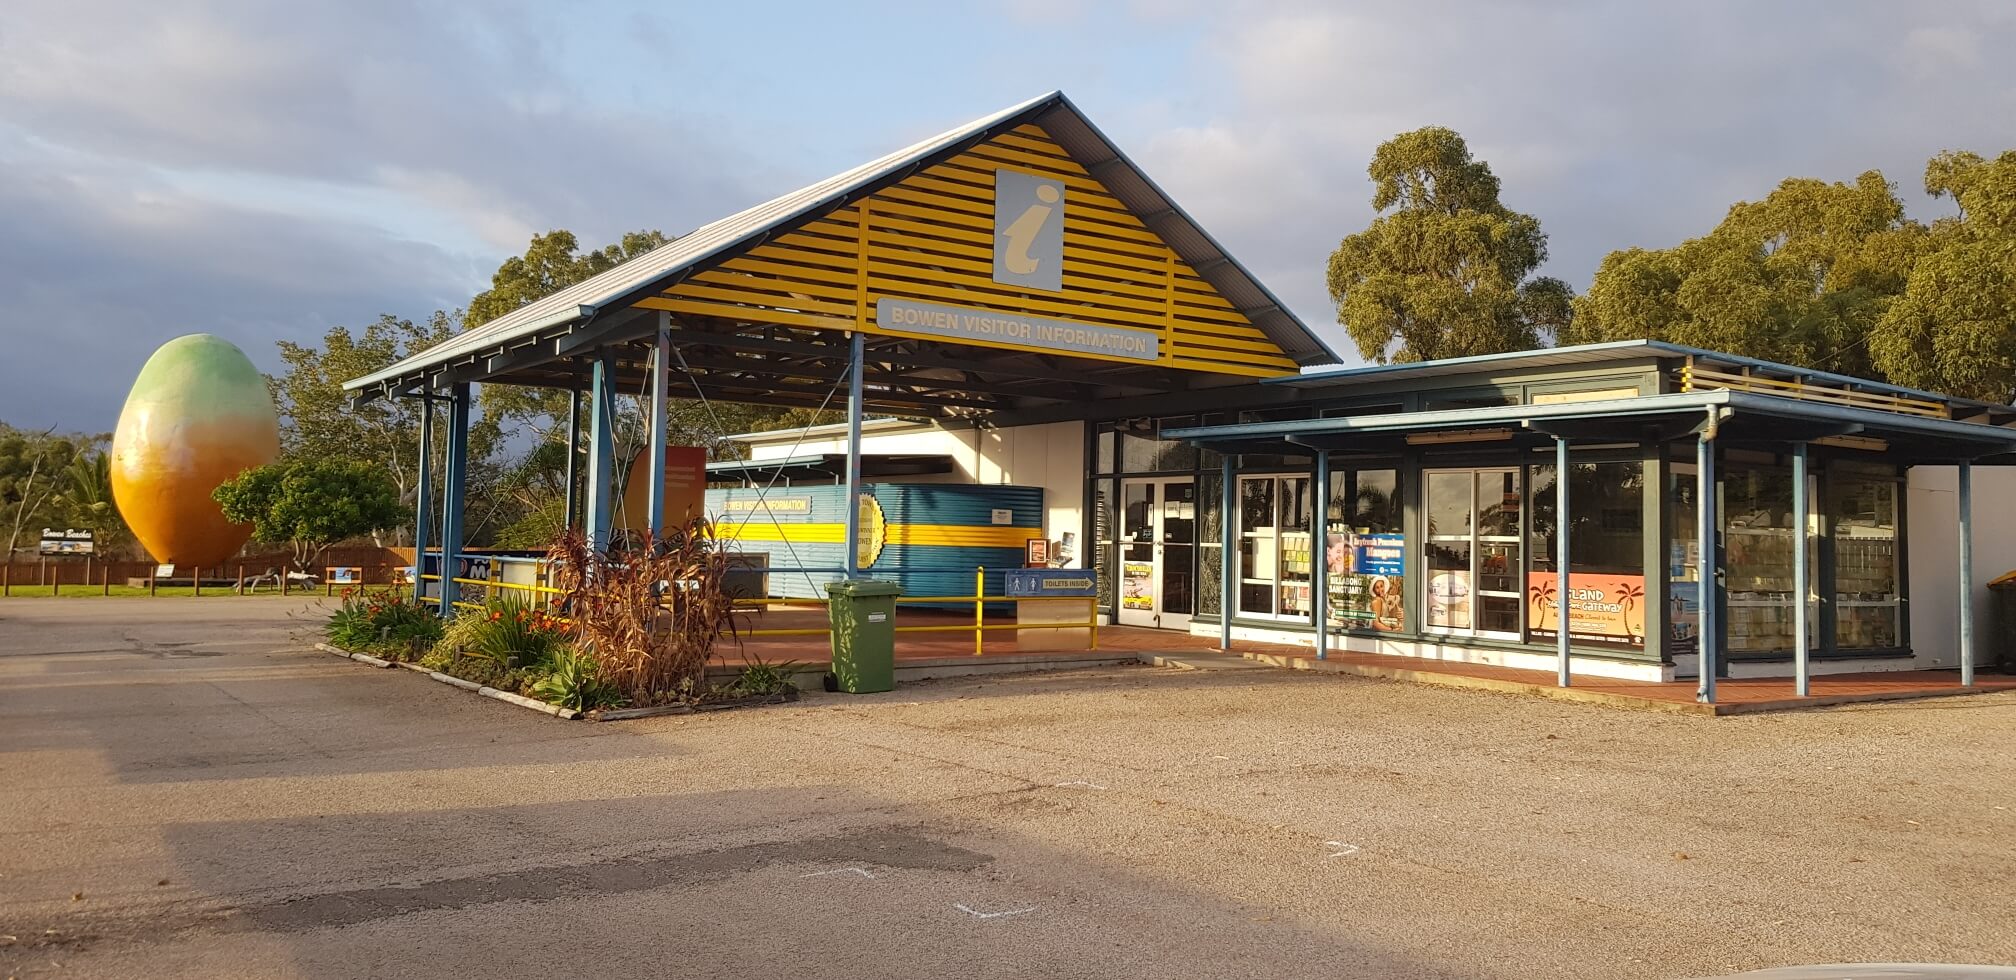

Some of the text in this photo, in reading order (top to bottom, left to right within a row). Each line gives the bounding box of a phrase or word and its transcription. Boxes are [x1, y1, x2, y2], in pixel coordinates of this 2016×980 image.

[1002, 184, 1060, 275] i
[891, 306, 1147, 353] BOWEN VISITOR INFORMATION
[723, 500, 743, 511] BOWEN
[767, 500, 806, 511] INFORMATION
[1045, 580, 1089, 588] TOILETS INSIDE
[1329, 576, 1363, 586] BILLABONG
[1328, 585, 1363, 594] SANCTUARY
